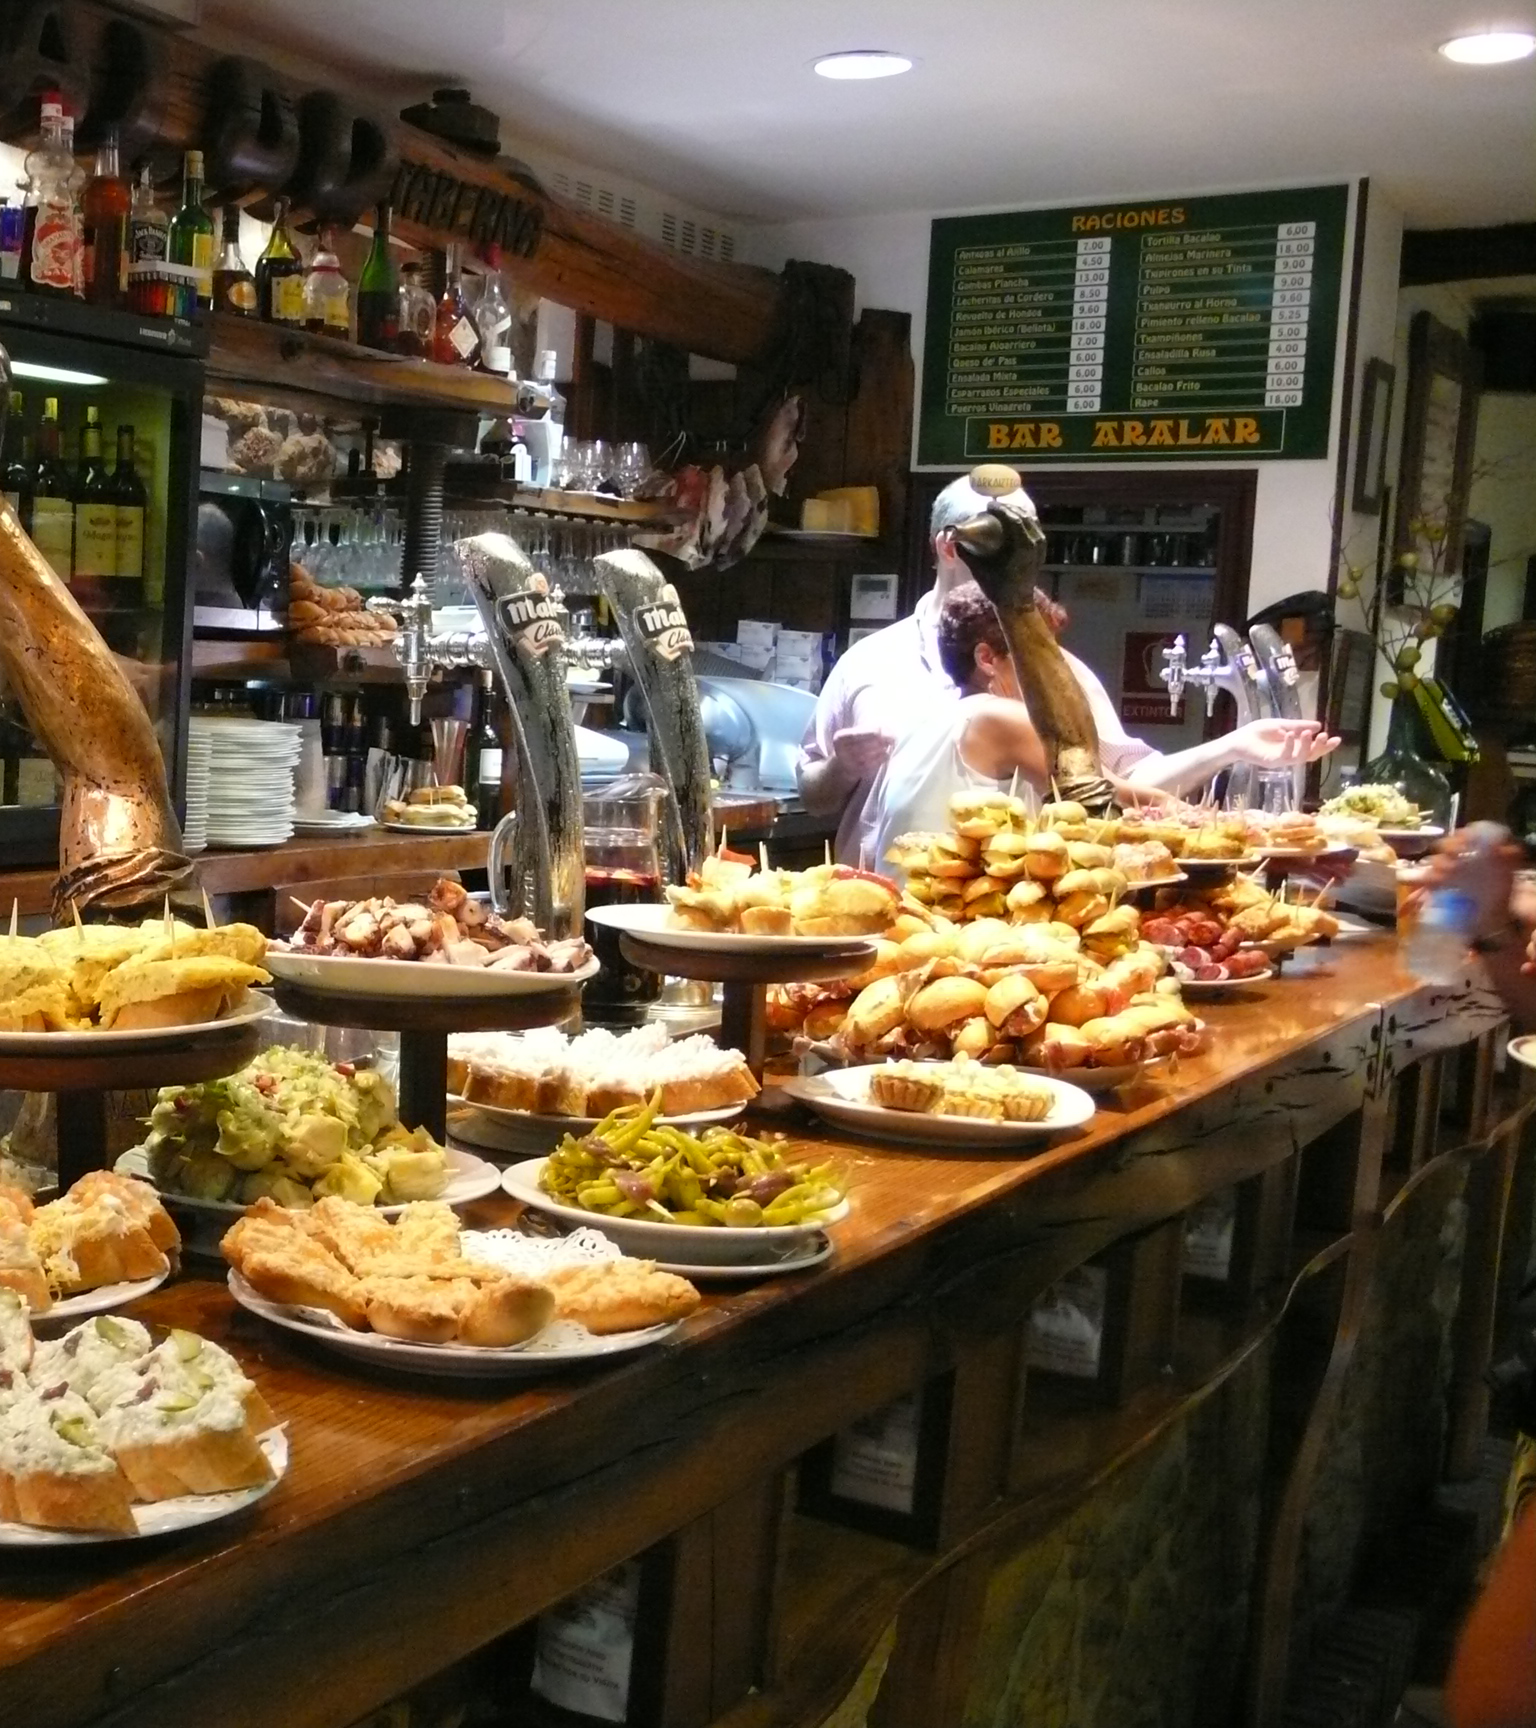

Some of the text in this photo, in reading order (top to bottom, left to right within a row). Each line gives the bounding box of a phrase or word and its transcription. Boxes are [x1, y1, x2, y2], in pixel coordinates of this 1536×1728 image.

[1072, 208, 1185, 232] RACIONES
[1147, 233, 1221, 247] Tortilla Bacalao
[1145, 249, 1231, 263] Almejas Marinera
[958, 264, 1004, 275] Calamares
[1197, 267, 1209, 275] en
[1211, 266, 1223, 275] su
[1226, 264, 1252, 273] Tinta
[994, 277, 1029, 289] Plancha
[1143, 285, 1170, 296] Pulpo
[1004, 294, 1014, 304] de
[1016, 292, 1054, 303] Cordero
[1194, 299, 1204, 309] al
[1206, 297, 1237, 308] Horno
[956, 311, 993, 322] Revuelto
[995, 310, 1005, 319] de
[1140, 312, 1261, 328] Pimiento relleno Bacalao
[954, 326, 982, 337] Jamón
[984, 324, 1014, 335] Ibérico
[1138, 348, 1216, 361] Ensaladilla Rusa
[953, 357, 980, 367] Queso
[952, 371, 1017, 383] Ensalada Mixta
[1137, 366, 1166, 376] Callos
[1003, 386, 1050, 396] Especiales
[1136, 381, 1200, 393] Bacalao Frito
[951, 404, 986, 414] Puerros
[1135, 398, 1159, 408] Rape
[987, 417, 1260, 449] BAR ARALAR
